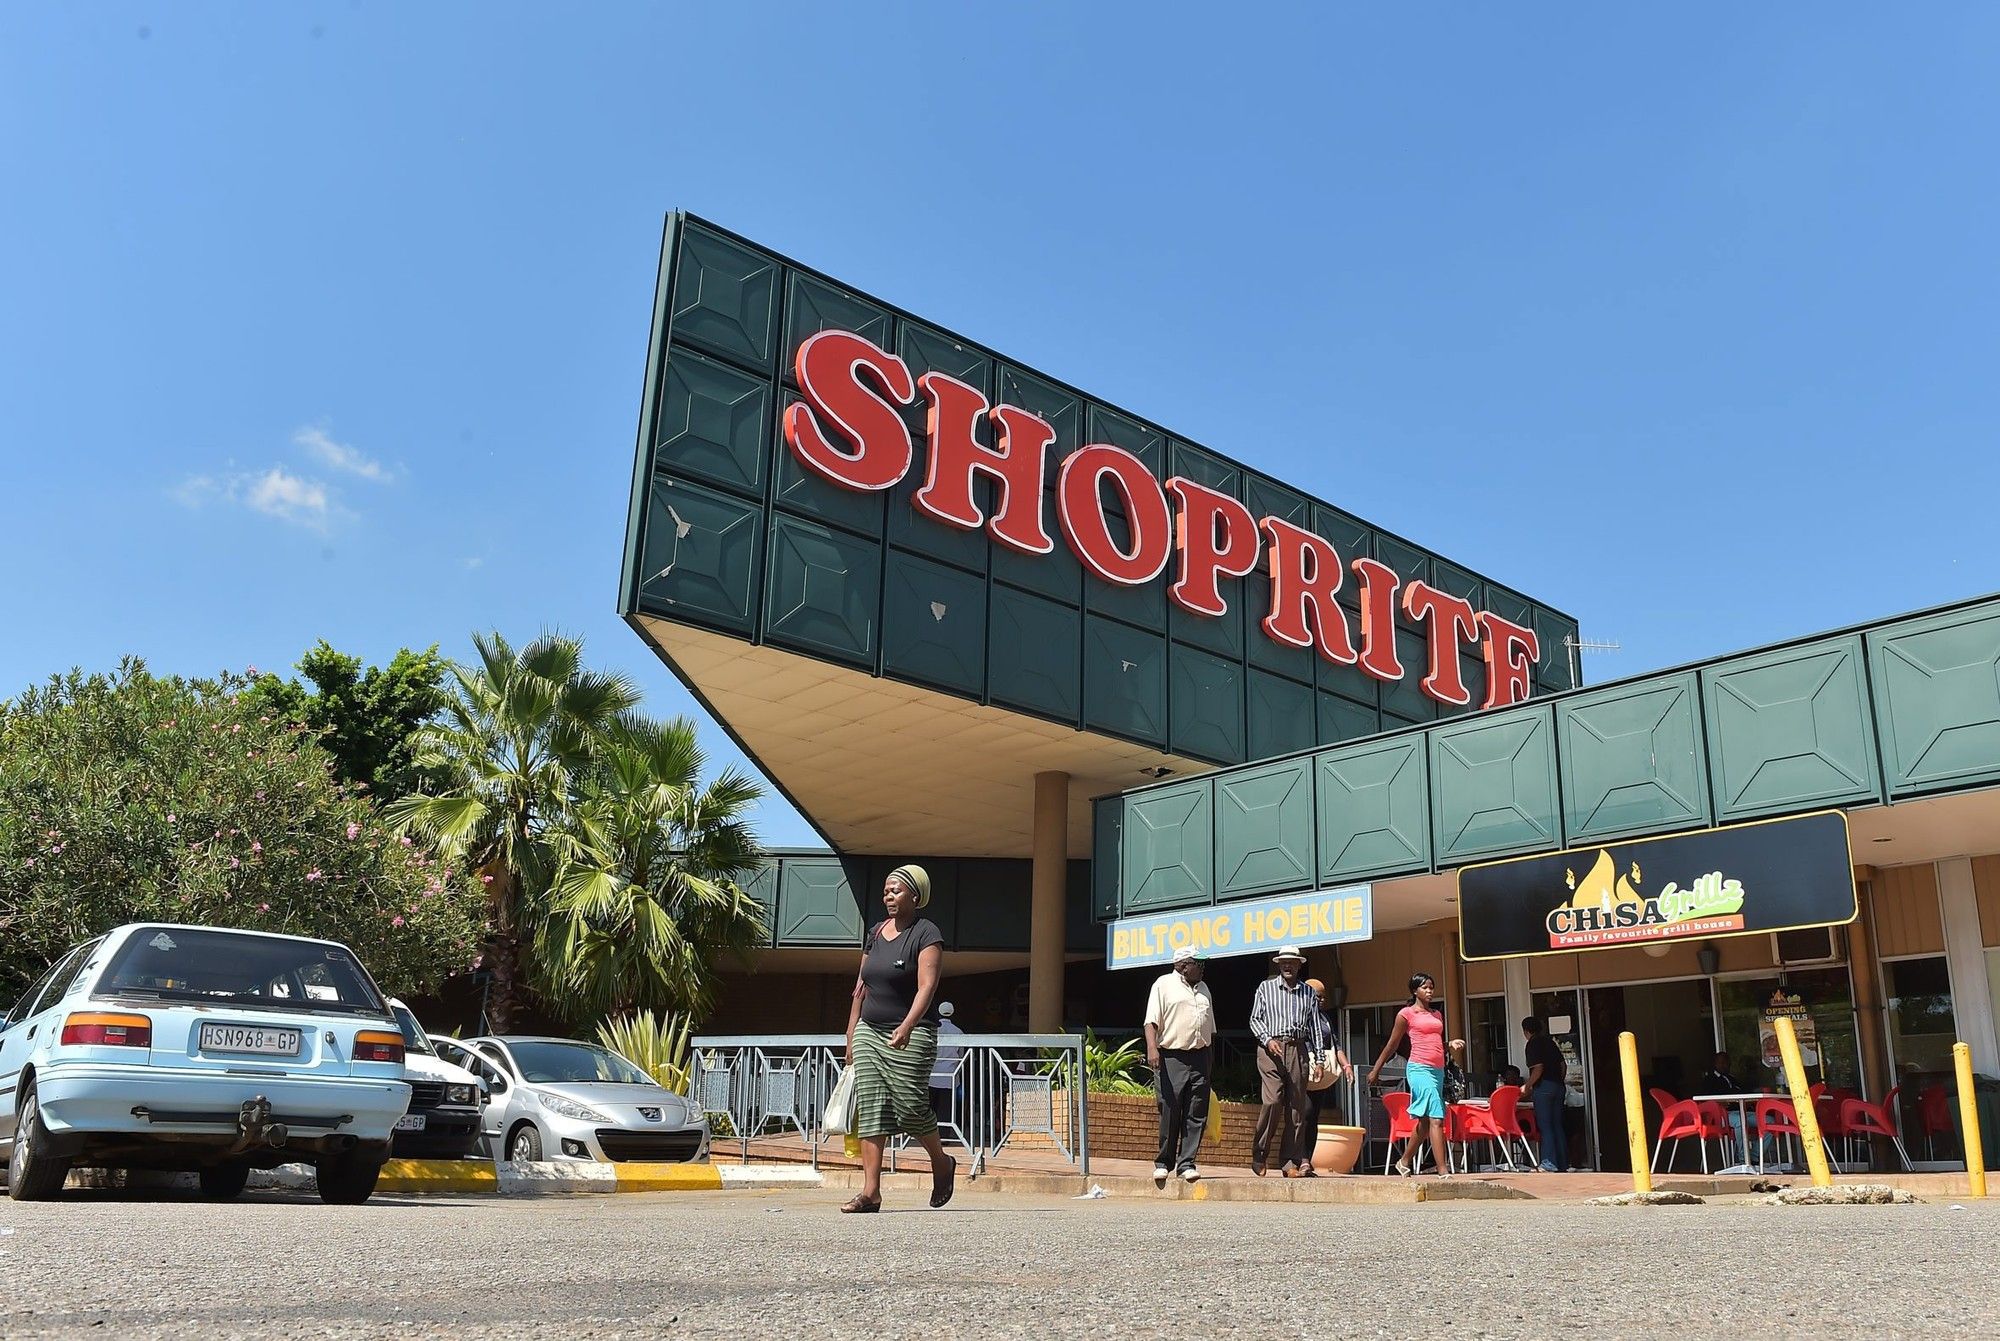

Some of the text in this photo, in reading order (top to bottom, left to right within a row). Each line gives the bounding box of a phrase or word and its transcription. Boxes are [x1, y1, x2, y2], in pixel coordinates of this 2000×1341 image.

[783, 328, 1540, 709] SHOPRITE
[1658, 871, 1745, 920] Grillz
[1113, 896, 1363, 960] BILTONG HOEKIE
[1559, 920, 1733, 944] Family favourite grill house
[1766, 1006, 1806, 1015] OPENING
[204, 1028, 297, 1050] HSN968 GP
[412, 1117, 424, 1128] GP
